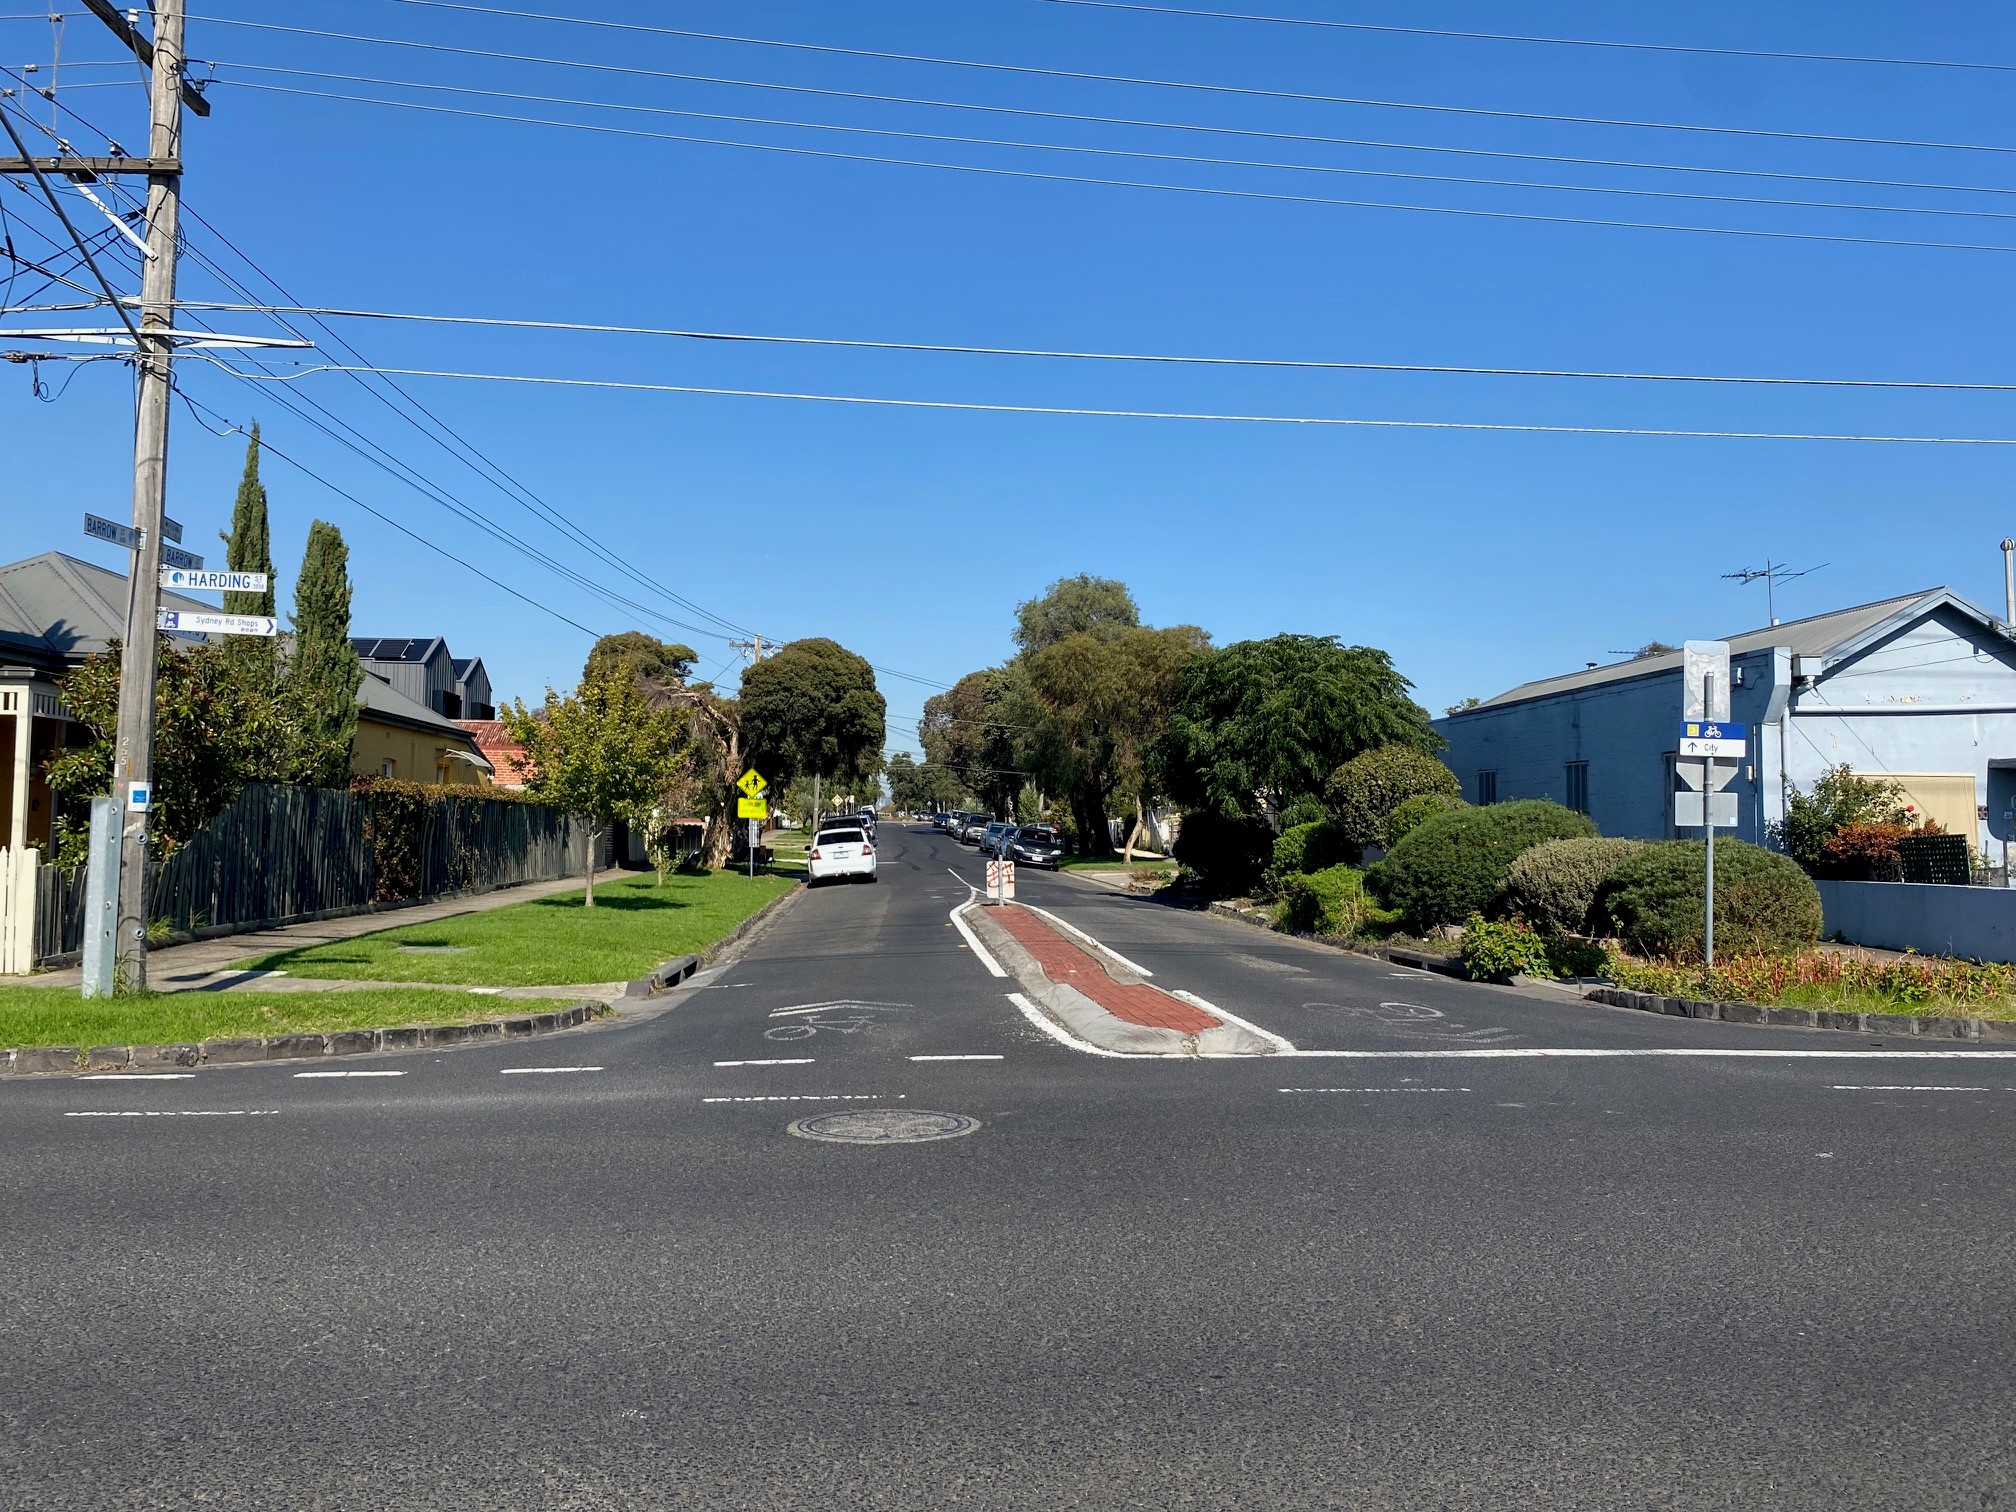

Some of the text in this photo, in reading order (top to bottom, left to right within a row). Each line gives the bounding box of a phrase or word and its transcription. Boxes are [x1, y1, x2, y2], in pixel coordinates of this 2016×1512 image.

[87, 518, 117, 540] BARROW
[167, 549, 193, 568] BARROW
[189, 573, 250, 589] HARDING
[196, 616, 223, 626] Sydney
[238, 619, 259, 628] Shops
[1704, 743, 1718, 753] City
